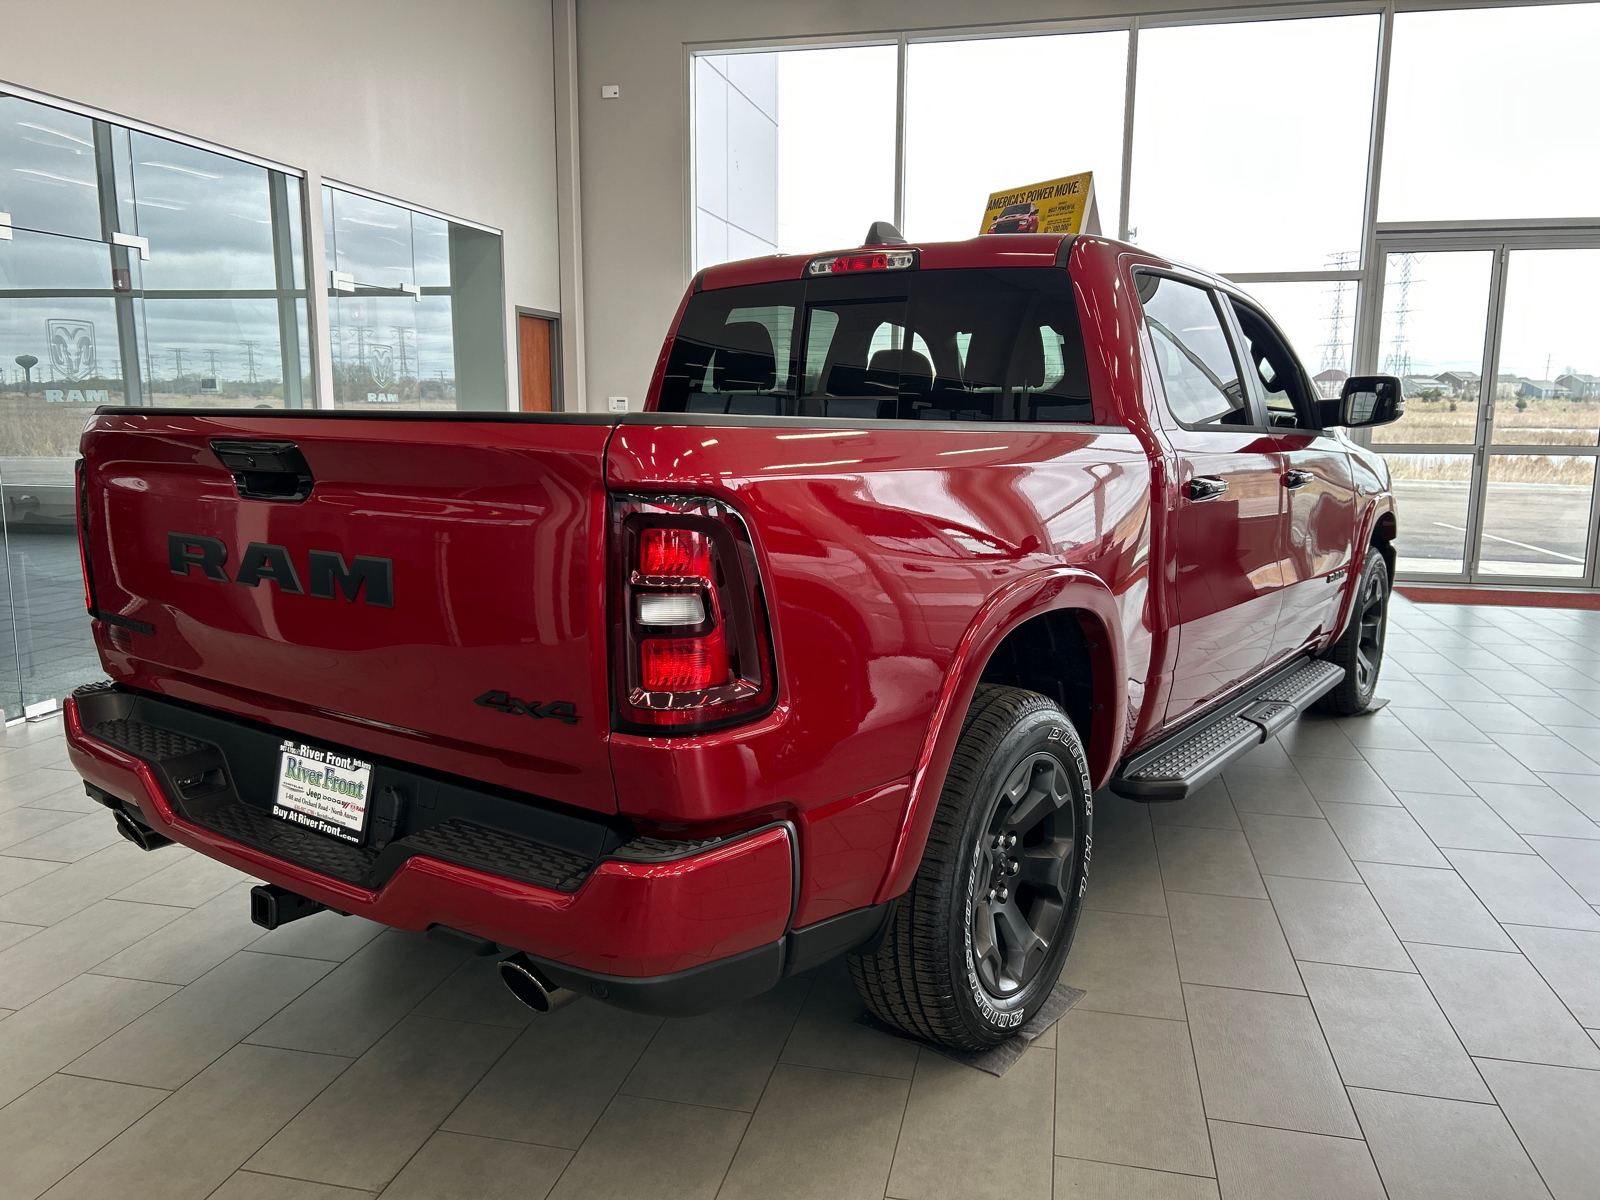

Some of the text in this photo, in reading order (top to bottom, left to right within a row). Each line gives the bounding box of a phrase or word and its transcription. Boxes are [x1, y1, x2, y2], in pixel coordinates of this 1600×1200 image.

[987, 192, 1026, 211] AMERICA'S
[1026, 186, 1054, 202] POWER
[45, 389, 109, 403] RAM
[367, 392, 399, 402] RAM
[168, 531, 395, 608] RAM
[300, 744, 325, 762] River
[326, 751, 351, 770] Front
[284, 755, 365, 800] River Front
[1048, 727, 1093, 816] DUELER
[294, 795, 302, 804] and
[302, 797, 318, 808] Orchard
[318, 802, 329, 812] Road
[331, 806, 344, 817] North
[306, 788, 321, 801] Jeep
[273, 805, 288, 820] Buy
[289, 810, 298, 821] At
[298, 814, 319, 830] River
[965, 839, 1025, 1028] BRIDGESTONE
